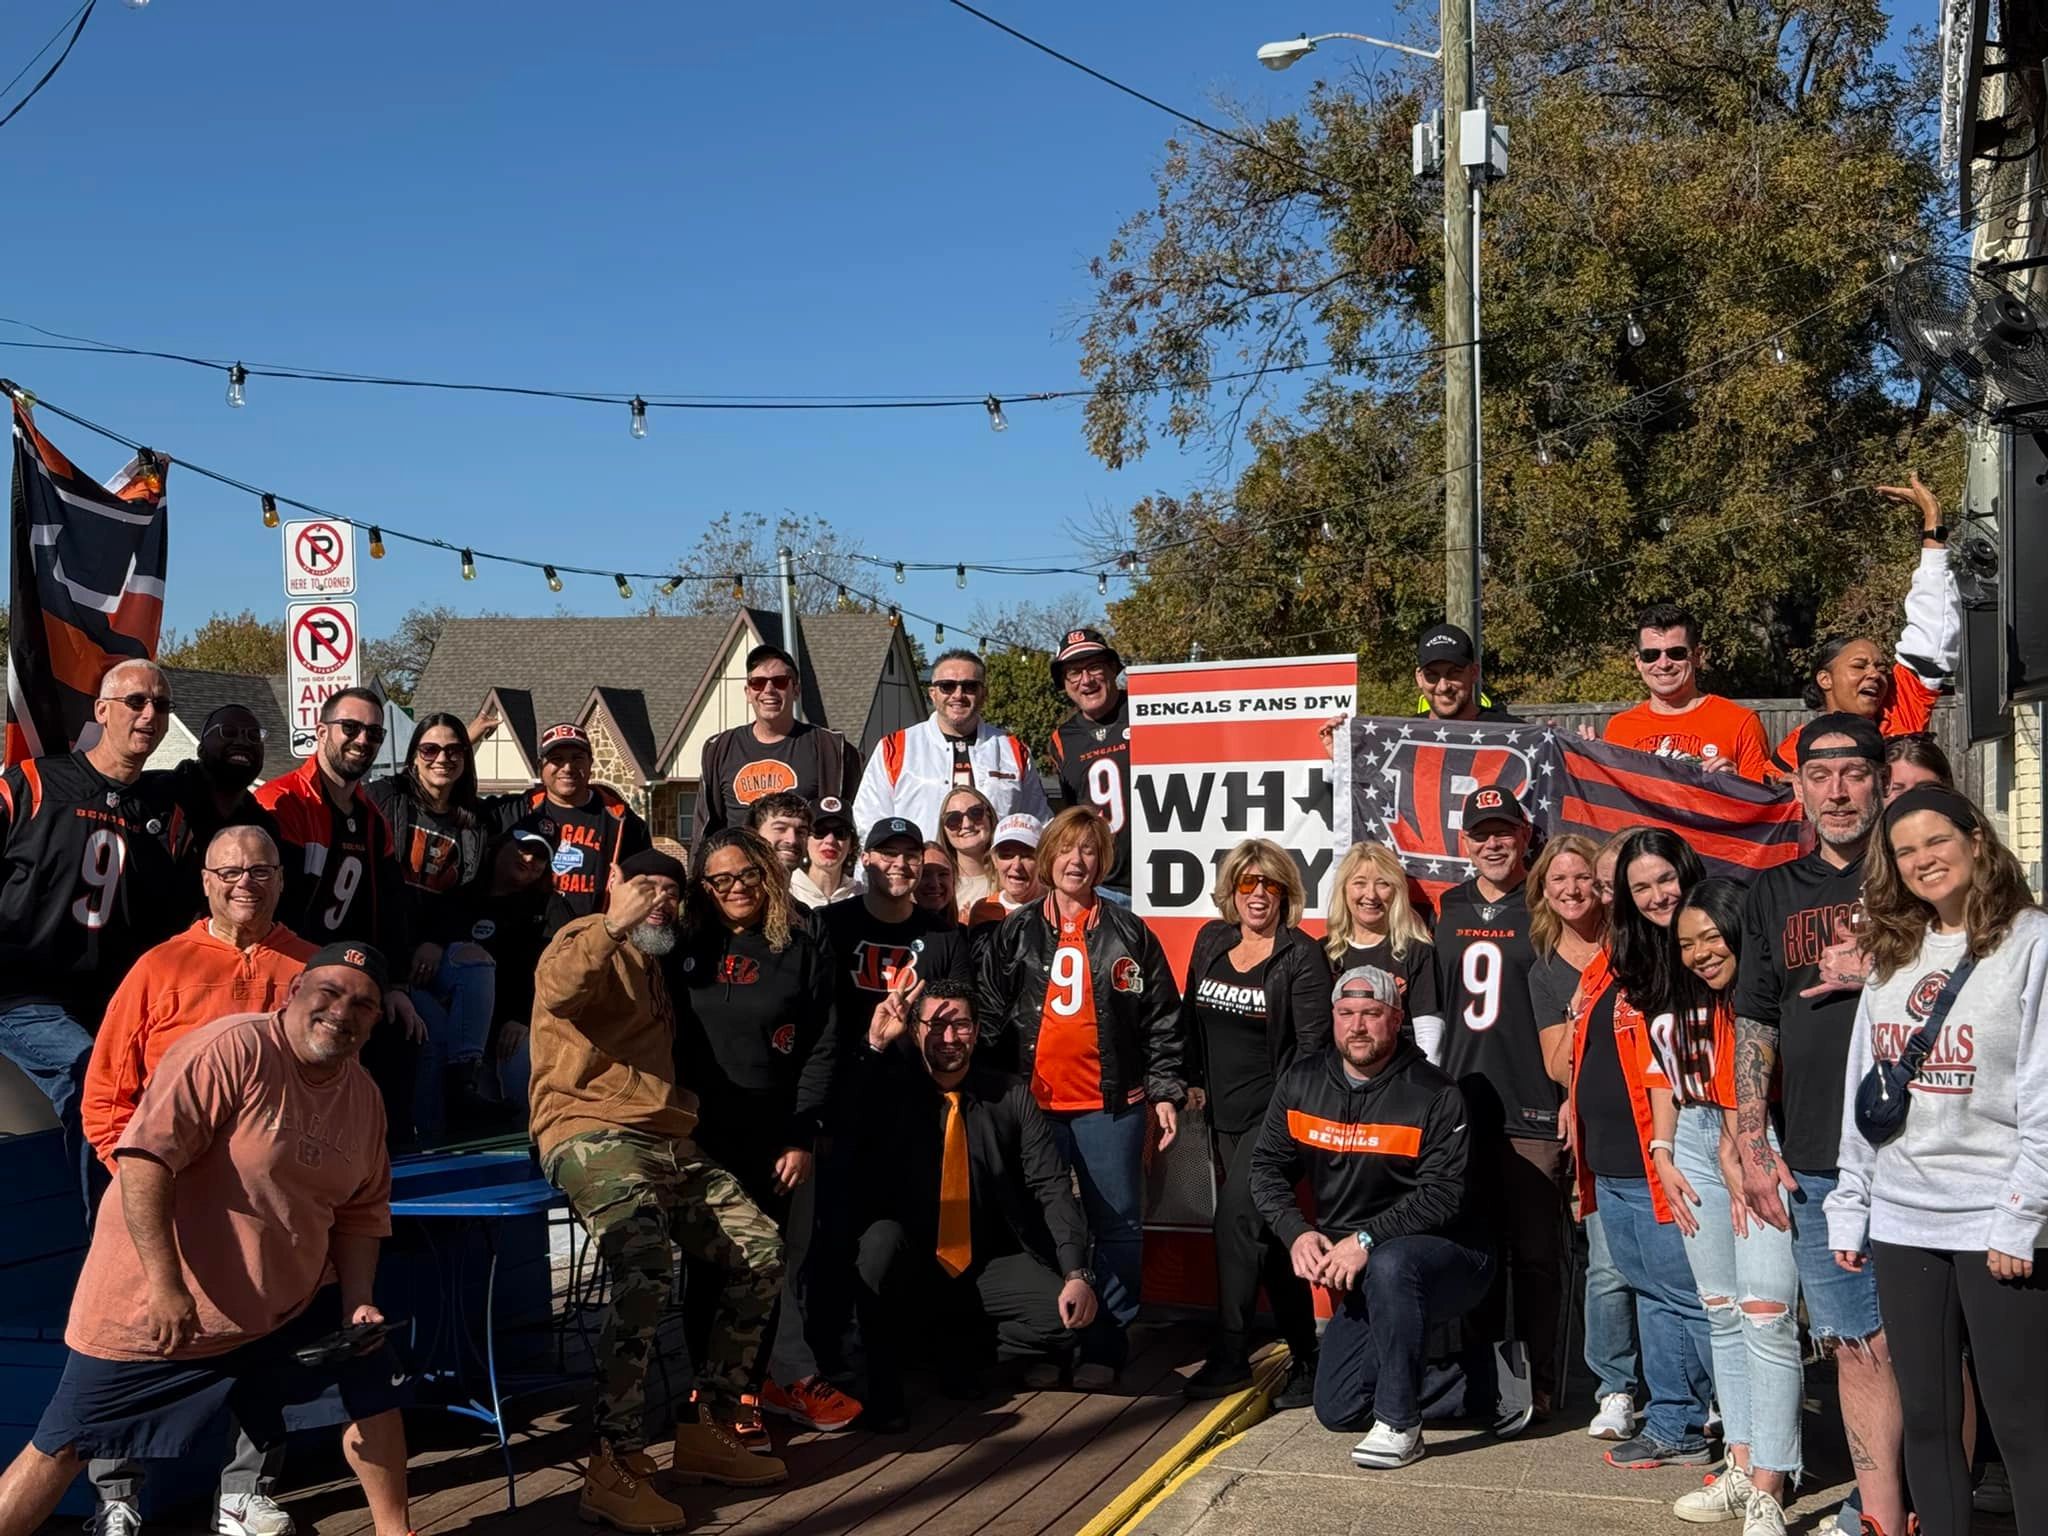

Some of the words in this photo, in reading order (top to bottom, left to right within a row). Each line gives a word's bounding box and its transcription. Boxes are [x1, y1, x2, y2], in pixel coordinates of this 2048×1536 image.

[290, 578, 307, 590] HERE
[311, 578, 320, 589] TO
[324, 576, 350, 589] CORNER
[297, 707, 318, 727] TI
[1136, 700, 1231, 717] BENGALS
[1239, 698, 1297, 713] FANS
[1304, 694, 1352, 709] DFW
[1080, 743, 1127, 761] BENGALS
[741, 773, 784, 792] BENGALS
[1087, 758, 1125, 834] 9
[72, 829, 127, 930] 9
[1146, 848, 1333, 909] DY
[324, 856, 362, 930] 9
[1455, 929, 1516, 938] BENGALS
[1050, 946, 1084, 1017] 9
[1462, 940, 1503, 1031] 9
[1919, 1072, 1975, 1087] NNATI
